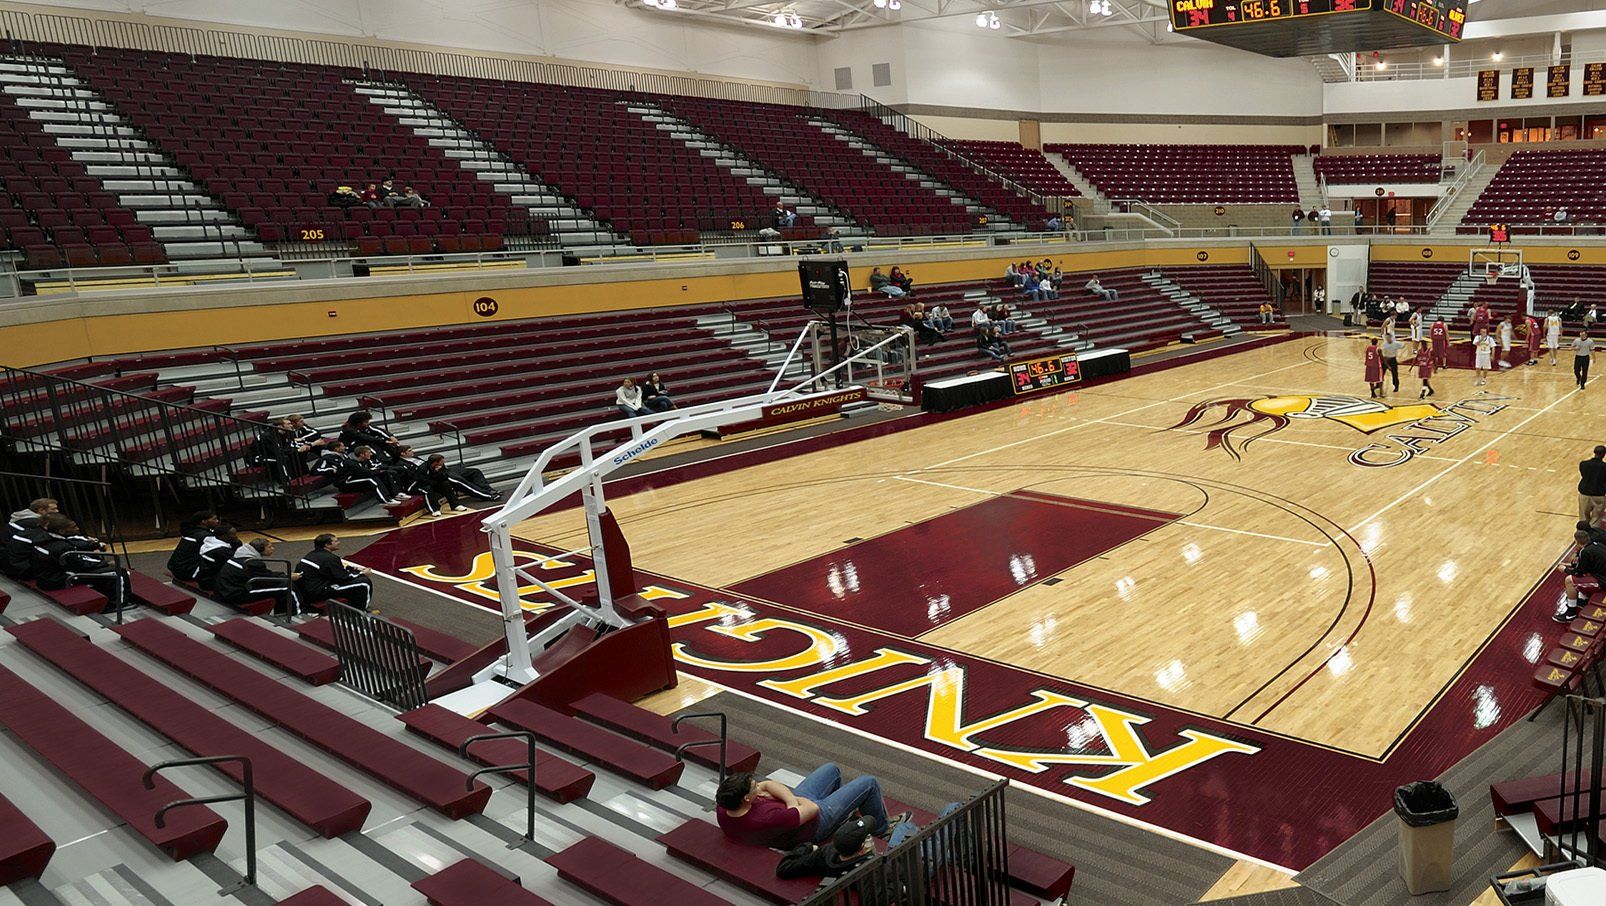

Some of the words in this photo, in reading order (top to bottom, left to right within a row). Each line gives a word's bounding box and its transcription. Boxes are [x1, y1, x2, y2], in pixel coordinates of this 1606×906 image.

[1244, 2, 1280, 18] 46.6
[731, 221, 745, 229] 206
[301, 229, 324, 240] 205
[476, 301, 496, 313] 104
[1433, 327, 1444, 336] 52
[1368, 351, 1374, 360] 5
[1030, 360, 1055, 374] 46.6
[771, 399, 811, 416] CALVIN
[813, 391, 862, 408] KNIGHTS
